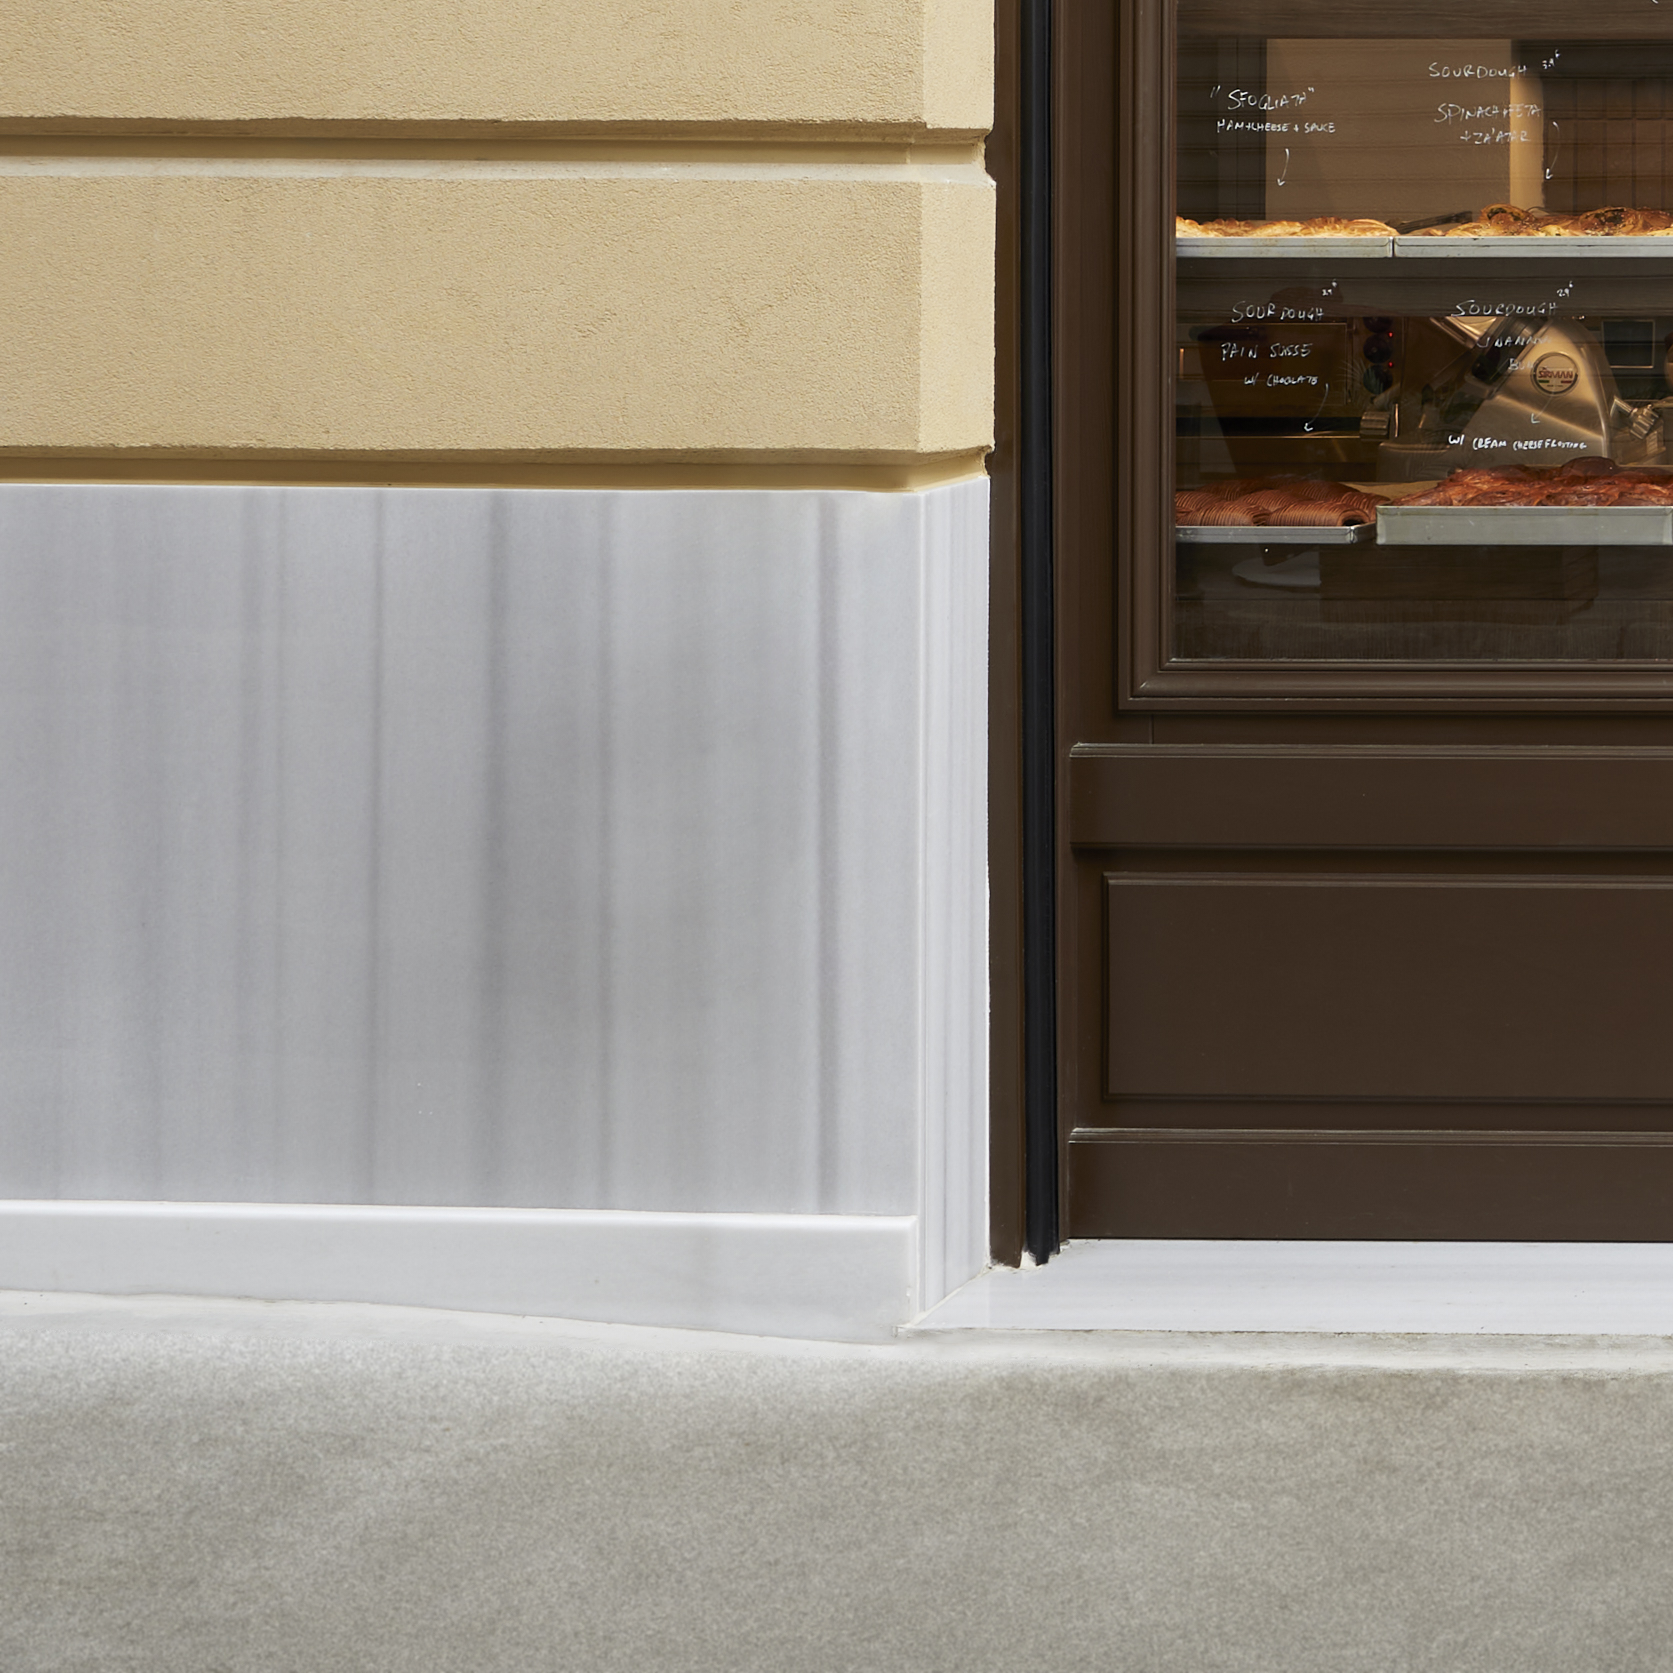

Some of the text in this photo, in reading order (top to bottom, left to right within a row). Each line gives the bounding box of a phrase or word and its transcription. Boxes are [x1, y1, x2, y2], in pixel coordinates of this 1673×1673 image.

[1428, 61, 1528, 80] SOURDOUGH
[1433, 103, 1501, 125] SPINACH
[1231, 300, 1325, 325] SOURDOUGH
[1450, 299, 1559, 318] SOURDOUGH
[1220, 341, 1259, 362] PAIN
